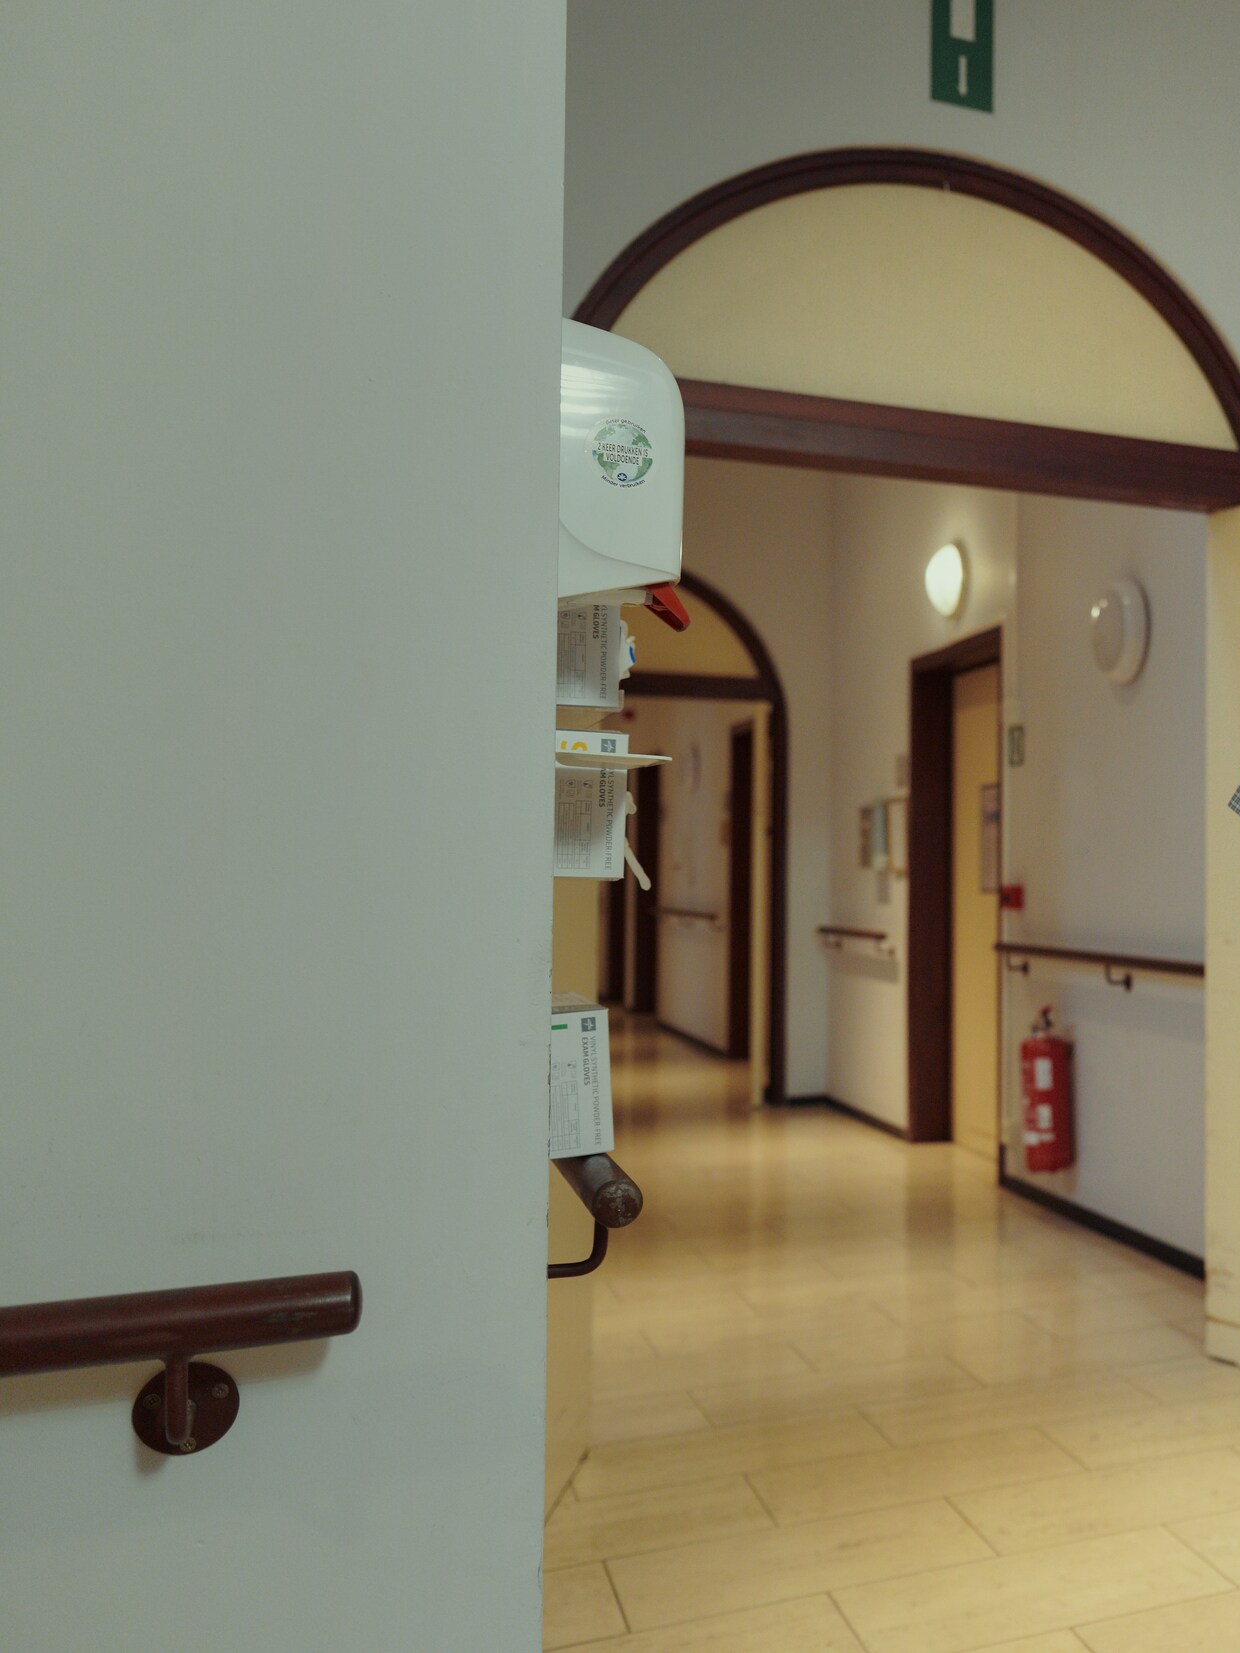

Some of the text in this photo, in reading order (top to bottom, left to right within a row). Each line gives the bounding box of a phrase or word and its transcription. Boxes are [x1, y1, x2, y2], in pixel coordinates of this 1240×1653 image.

[597, 442, 649, 457] 2 KEER DRUKKEN IS
[606, 453, 640, 466] VOLDOENDE
[592, 612, 600, 640] GLOVES
[600, 613, 608, 650] SYNTHETIC
[598, 779, 606, 808] GLOVES
[606, 780, 615, 819] SYNTHETIC
[590, 1035, 598, 1056] VINYL
[581, 1036, 591, 1086] EXAM GLOVES
[590, 1057, 600, 1096] SYNTHETIC
